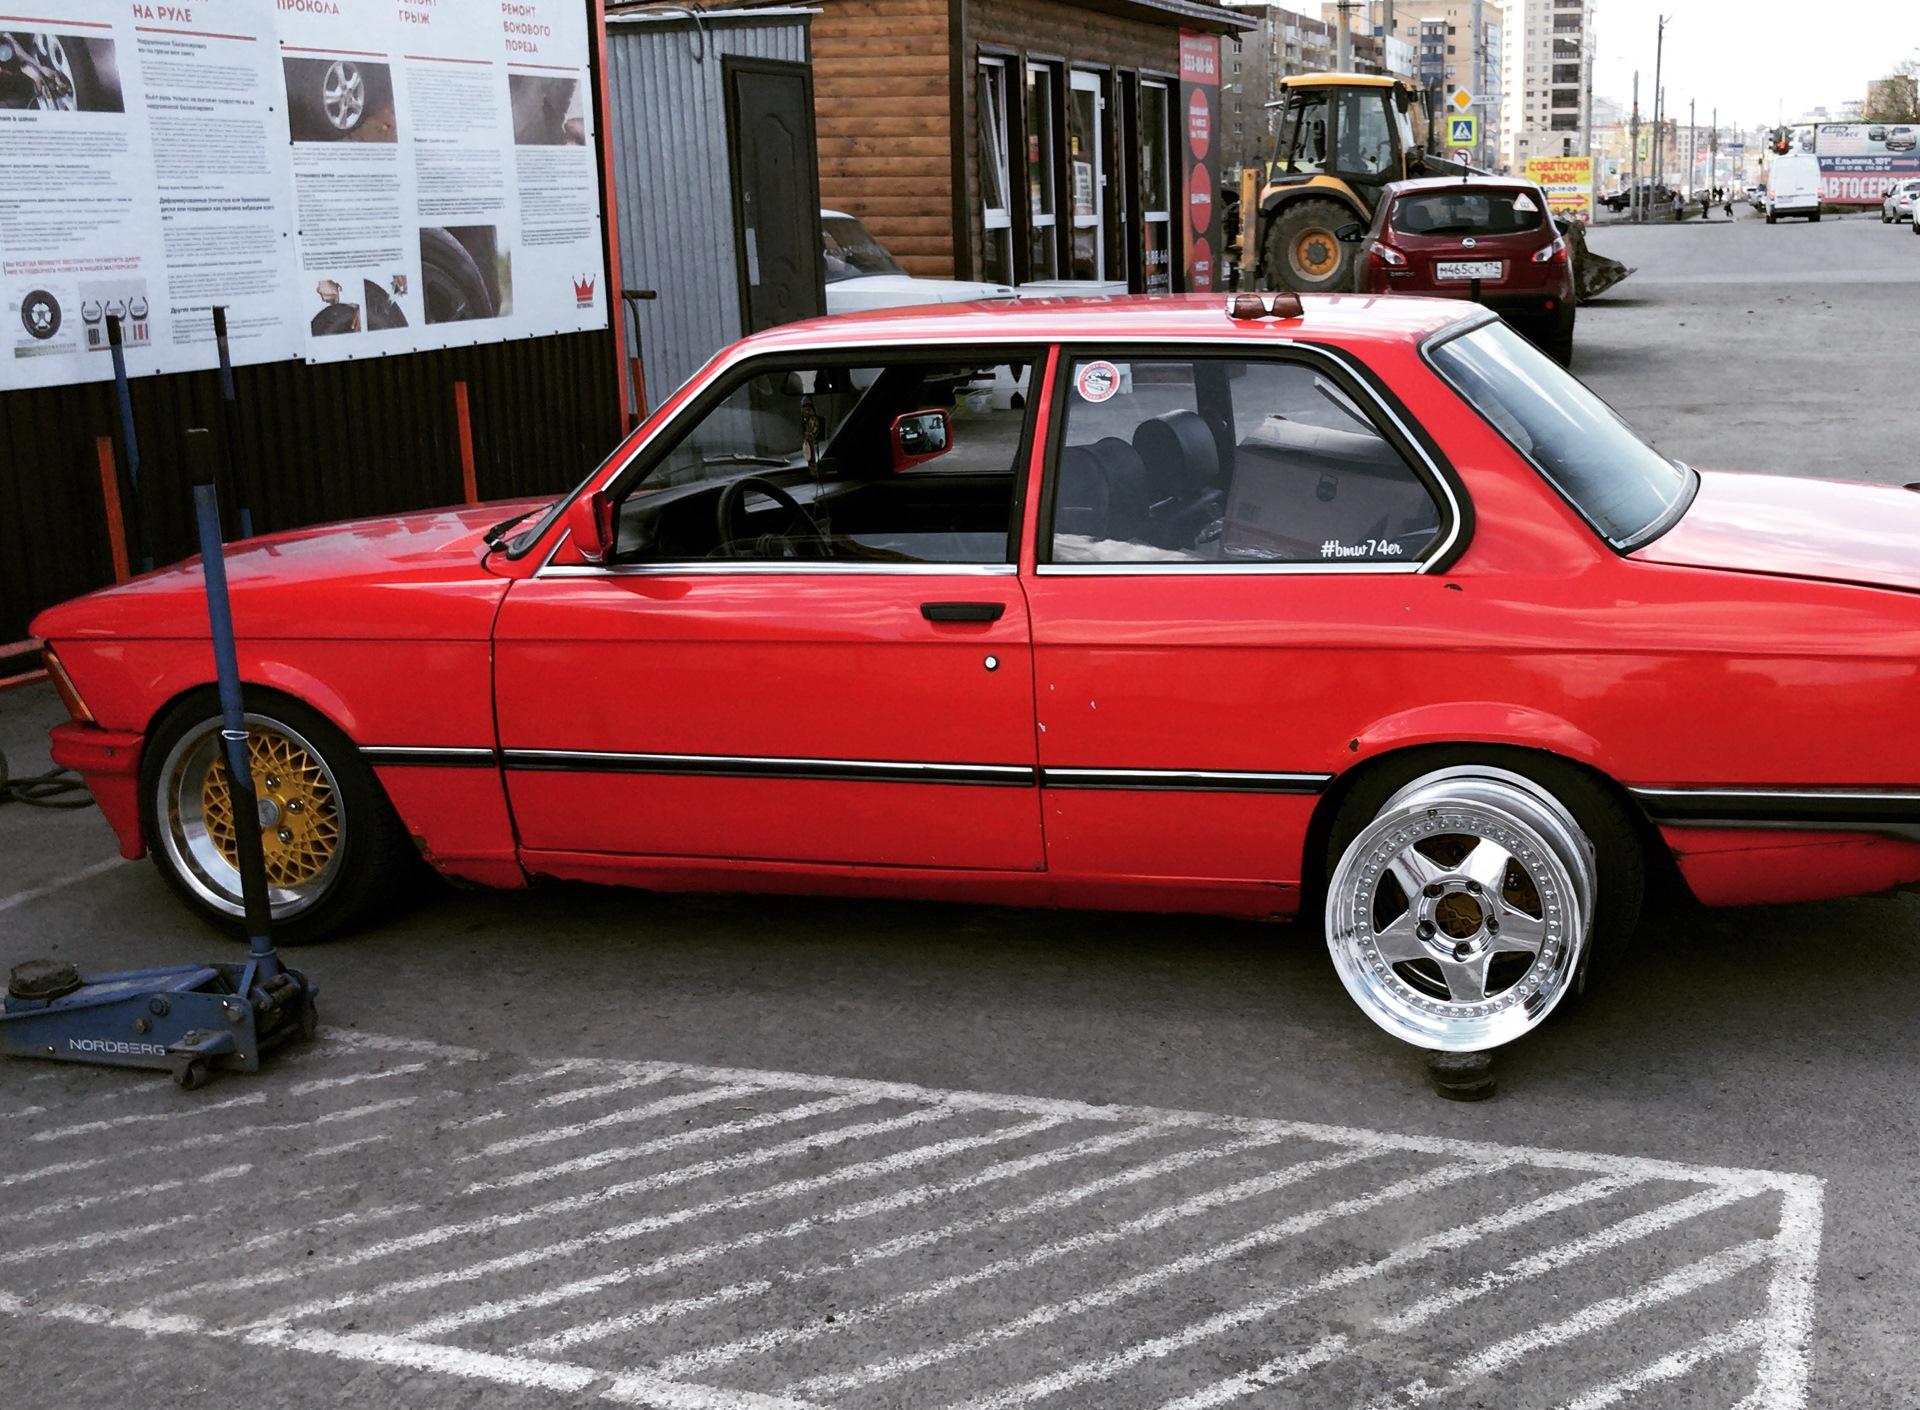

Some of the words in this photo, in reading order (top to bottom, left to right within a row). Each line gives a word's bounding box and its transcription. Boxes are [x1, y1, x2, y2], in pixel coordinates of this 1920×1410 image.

[133, 4, 154, 19] НА
[157, 6, 193, 22] РУЛЕ
[277, 0, 340, 15] ПРОКОЛА
[501, 2, 536, 18] РЕМОНТ
[398, 10, 431, 25] ГРЫЖ
[503, 20, 551, 37] БОКОВОГО
[505, 39, 539, 53] ПОРЕЗА
[1529, 159, 1590, 172] СОВЕТСКИЙ
[1540, 172, 1577, 184] РЫНОК
[1320, 539, 1403, 558] #bmw74er
[69, 1039, 166, 1056] NORDBERG
